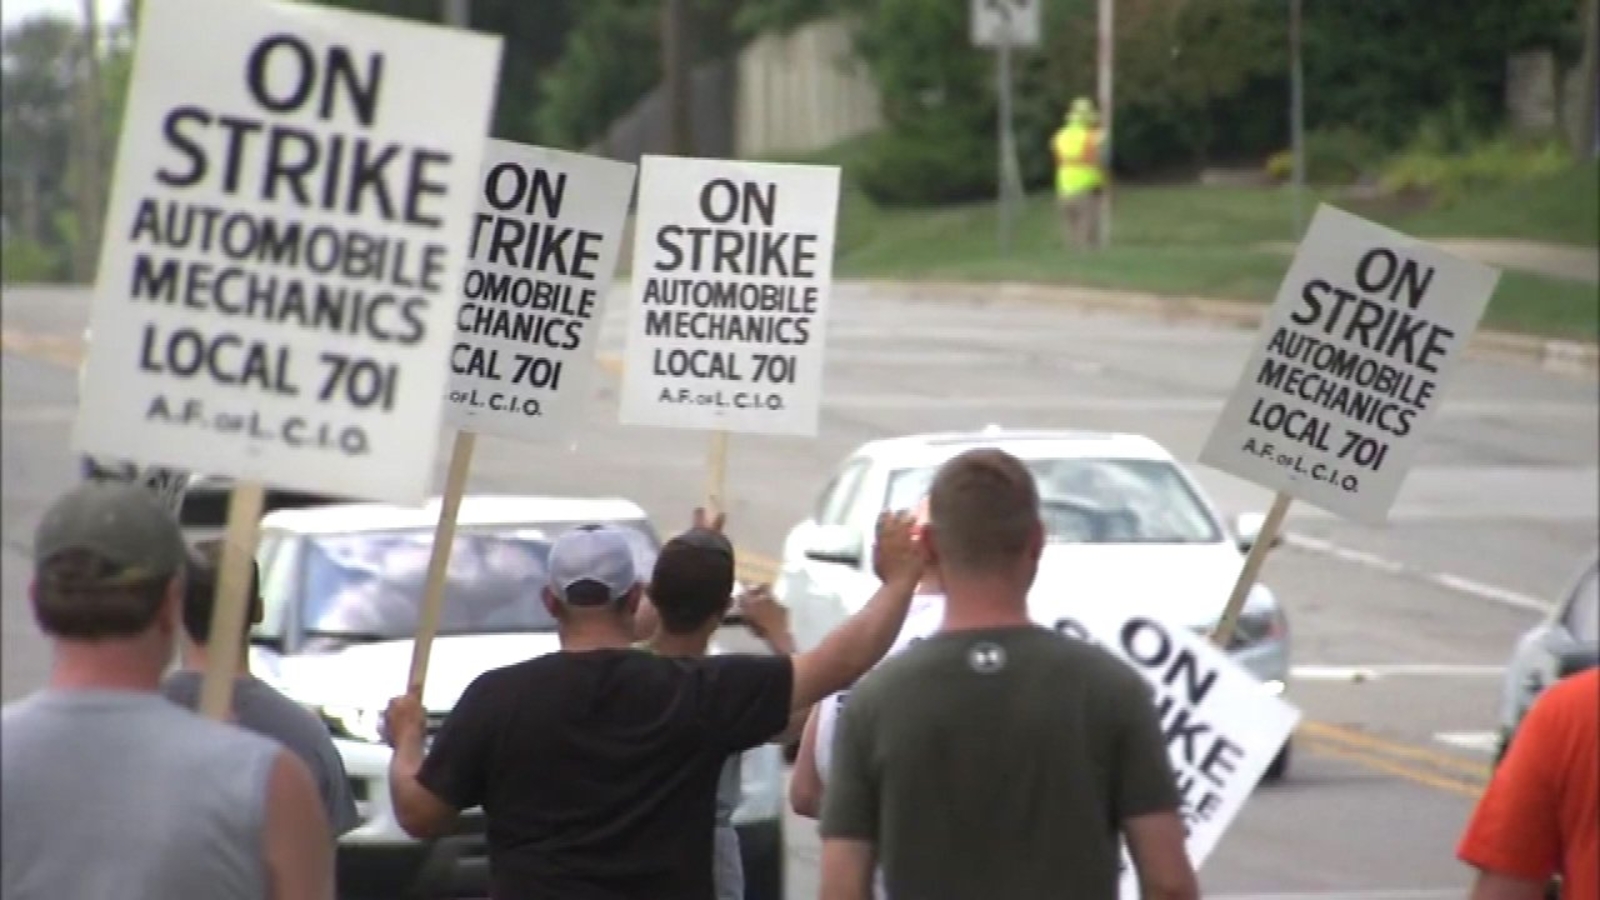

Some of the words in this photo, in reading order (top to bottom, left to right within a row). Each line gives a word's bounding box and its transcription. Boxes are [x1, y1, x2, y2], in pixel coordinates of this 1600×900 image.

[246, 32, 384, 127] ON
[154, 106, 453, 228] STRIKE
[484, 162, 566, 219] ON
[699, 177, 776, 226] ON
[130, 198, 447, 293] AUTOMOBILE
[468, 213, 603, 280] TRIKE
[653, 224, 818, 278] STRIKE
[1355, 247, 1436, 310] ON
[130, 254, 429, 345] MECHANICS
[457, 304, 584, 350] CHANICS
[464, 269, 596, 319] OMOBILE
[642, 277, 818, 314] AUTOMOBILE
[1290, 278, 1455, 374] STRIKE
[645, 311, 810, 345] MECHANICS
[139, 324, 299, 396] LOCAL
[318, 353, 398, 412] 701
[450, 342, 501, 381] CAL
[511, 354, 562, 391] 701
[653, 347, 741, 381] LOCAL
[751, 354, 796, 384] 701
[1257, 357, 1417, 437] MECHANICS
[1266, 326, 1436, 411] AUTOMOBILE
[1248, 398, 1331, 452] LOCAL
[1336, 429, 1389, 471] 701
[1119, 616, 1218, 706] ON
